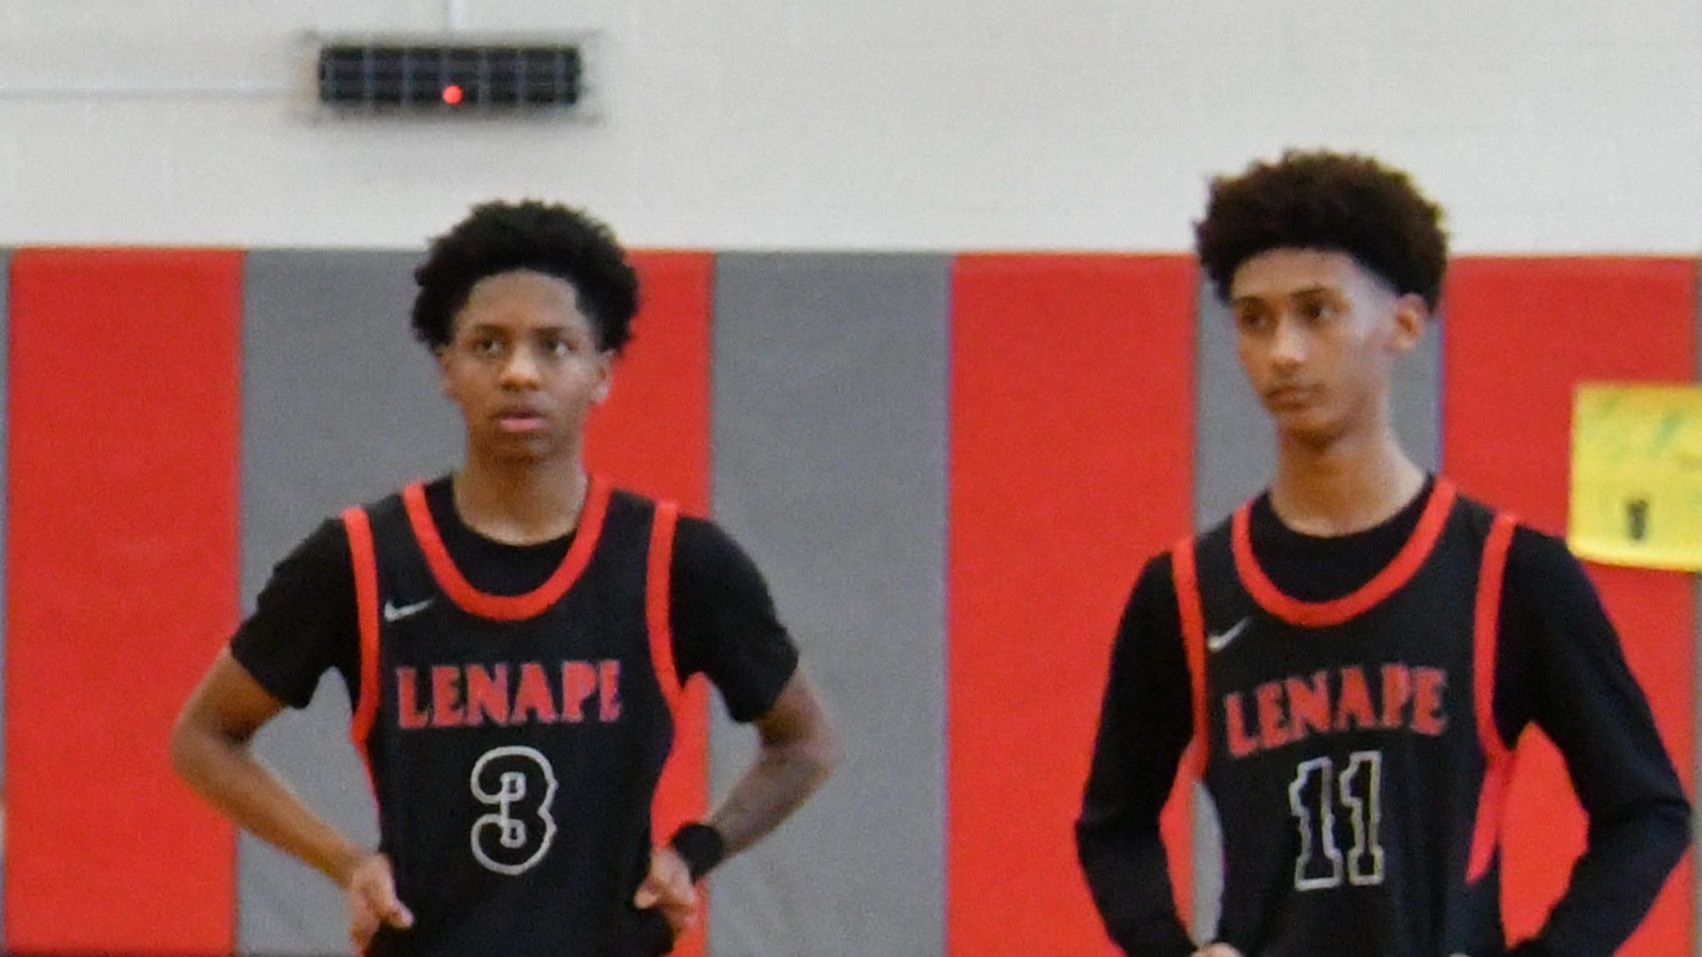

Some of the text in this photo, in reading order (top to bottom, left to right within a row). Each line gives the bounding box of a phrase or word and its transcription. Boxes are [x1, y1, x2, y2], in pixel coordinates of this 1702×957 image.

[396, 659, 623, 730] LENAPE
[1223, 662, 1450, 760] LENAPE
[470, 745, 559, 876] 3
[1288, 749, 1385, 892] 11
